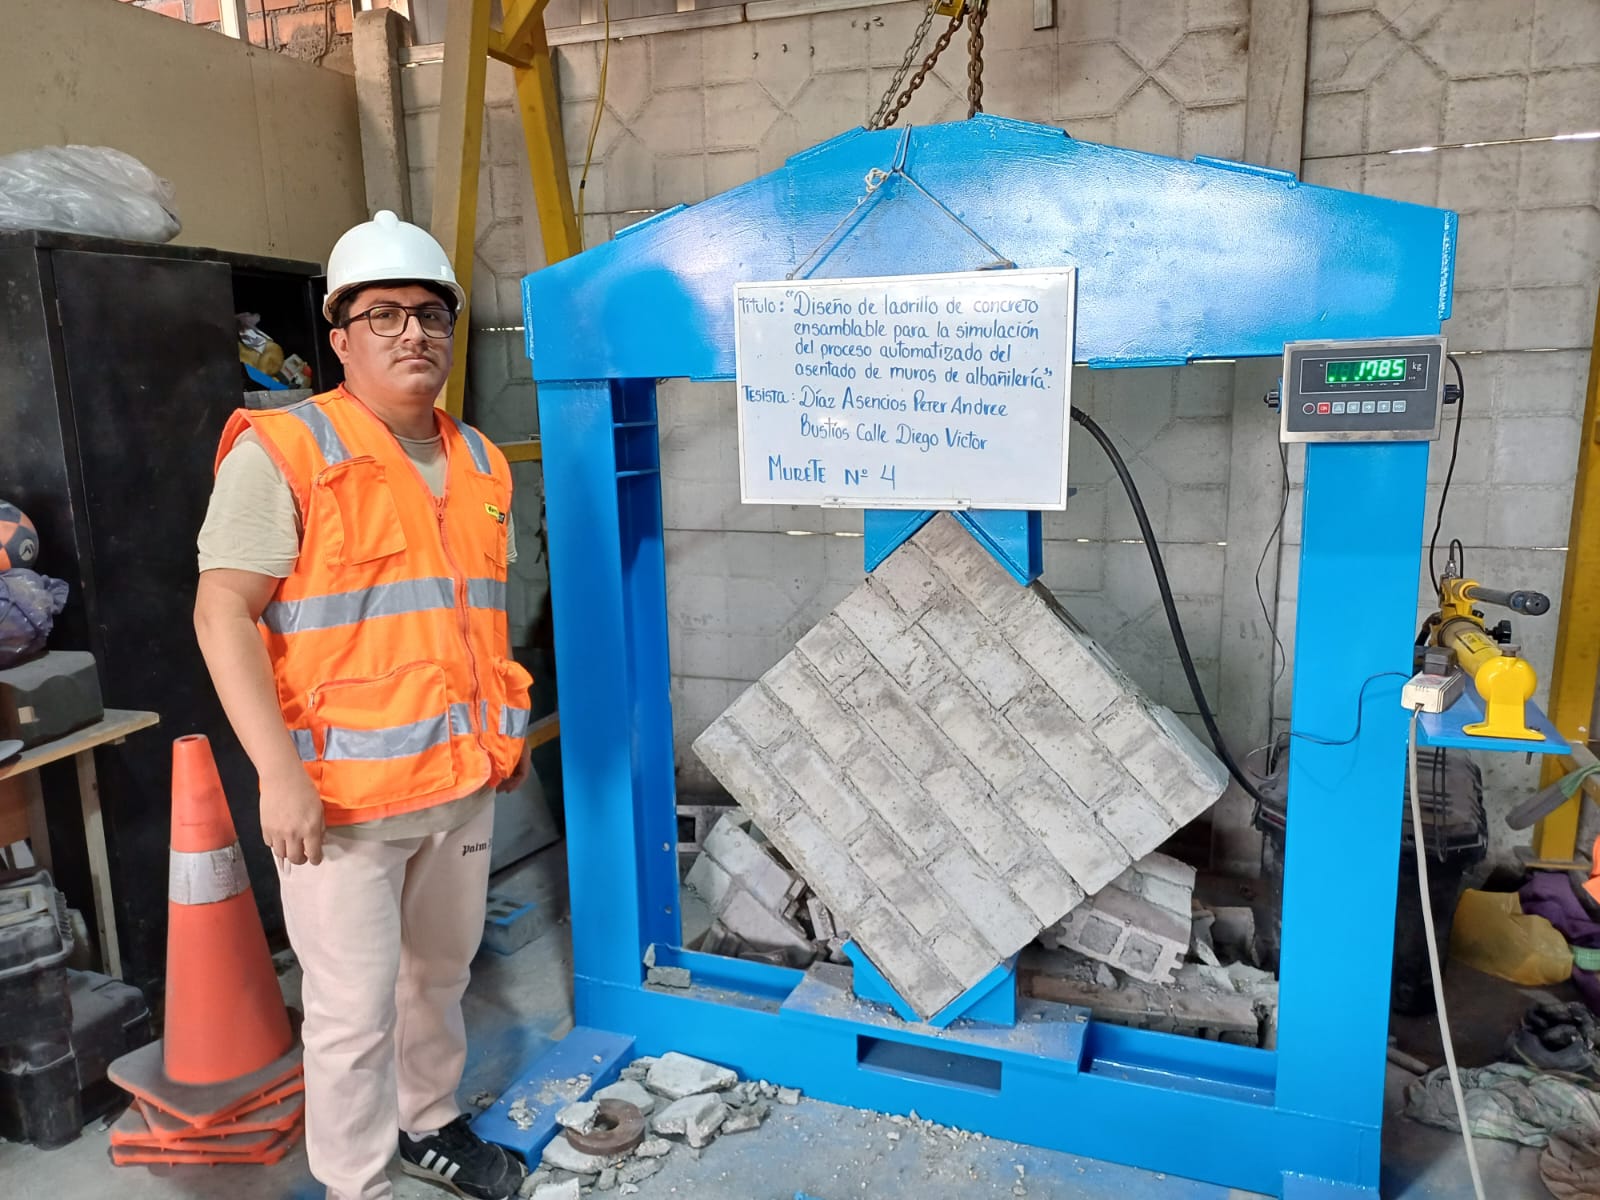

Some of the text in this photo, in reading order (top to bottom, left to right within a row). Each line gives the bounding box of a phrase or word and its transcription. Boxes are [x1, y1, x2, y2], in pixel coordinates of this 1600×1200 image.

[858, 297, 878, 315] de
[946, 296, 964, 314] de
[973, 299, 1039, 314] concreto
[794, 318, 1039, 343] ensamblable para la simulación
[795, 337, 1011, 363] del proceso automatizado del
[795, 361, 857, 379] asentado
[865, 363, 882, 379] de
[890, 367, 936, 383] muros
[945, 367, 959, 383] de
[1358, 359, 1423, 377] 1785 kg
[800, 385, 836, 408] Díaz
[842, 386, 907, 412] Asencios
[857, 423, 889, 443] Calle
[896, 423, 939, 453] Diego
[880, 464, 896, 490] 4
